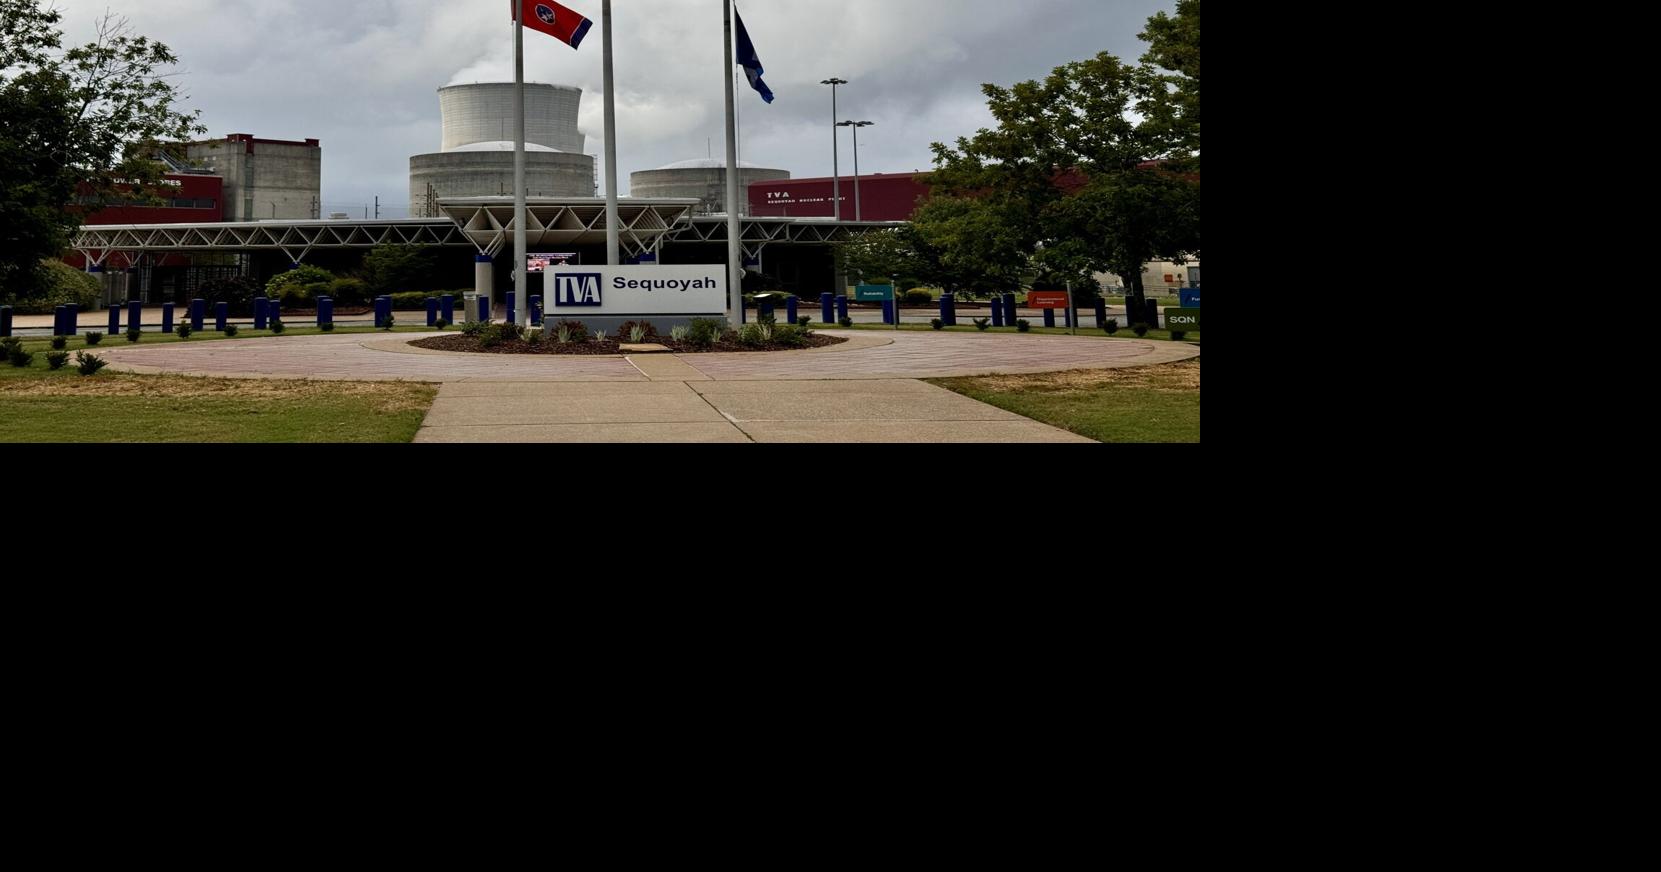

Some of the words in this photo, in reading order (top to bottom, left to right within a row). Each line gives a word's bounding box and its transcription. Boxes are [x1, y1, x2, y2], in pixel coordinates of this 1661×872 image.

[556, 276, 600, 303] TVA
[613, 276, 717, 292] Sequoyah
[1169, 316, 1196, 324] SQN
